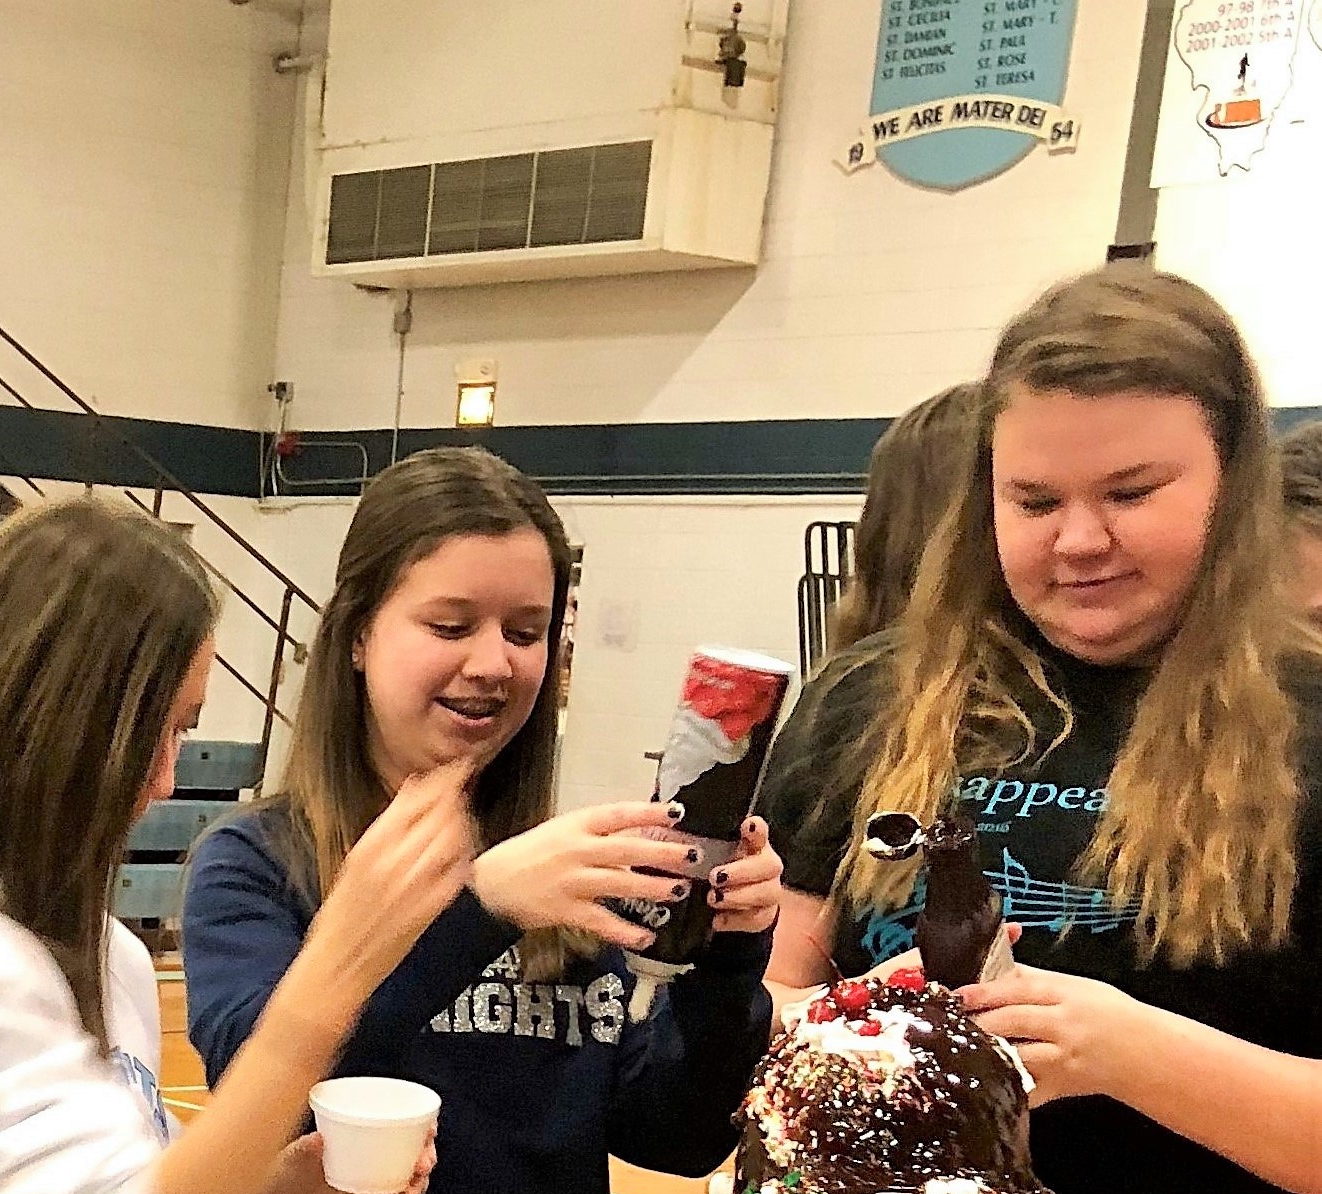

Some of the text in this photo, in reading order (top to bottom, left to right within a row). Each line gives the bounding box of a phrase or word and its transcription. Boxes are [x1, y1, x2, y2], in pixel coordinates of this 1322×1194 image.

[1003, 15, 1036, 30] MARY
[997, 52, 1027, 67] ROSE
[996, 70, 1035, 86] TERESA
[872, 100, 1047, 140] WE ARE MATER DEI
